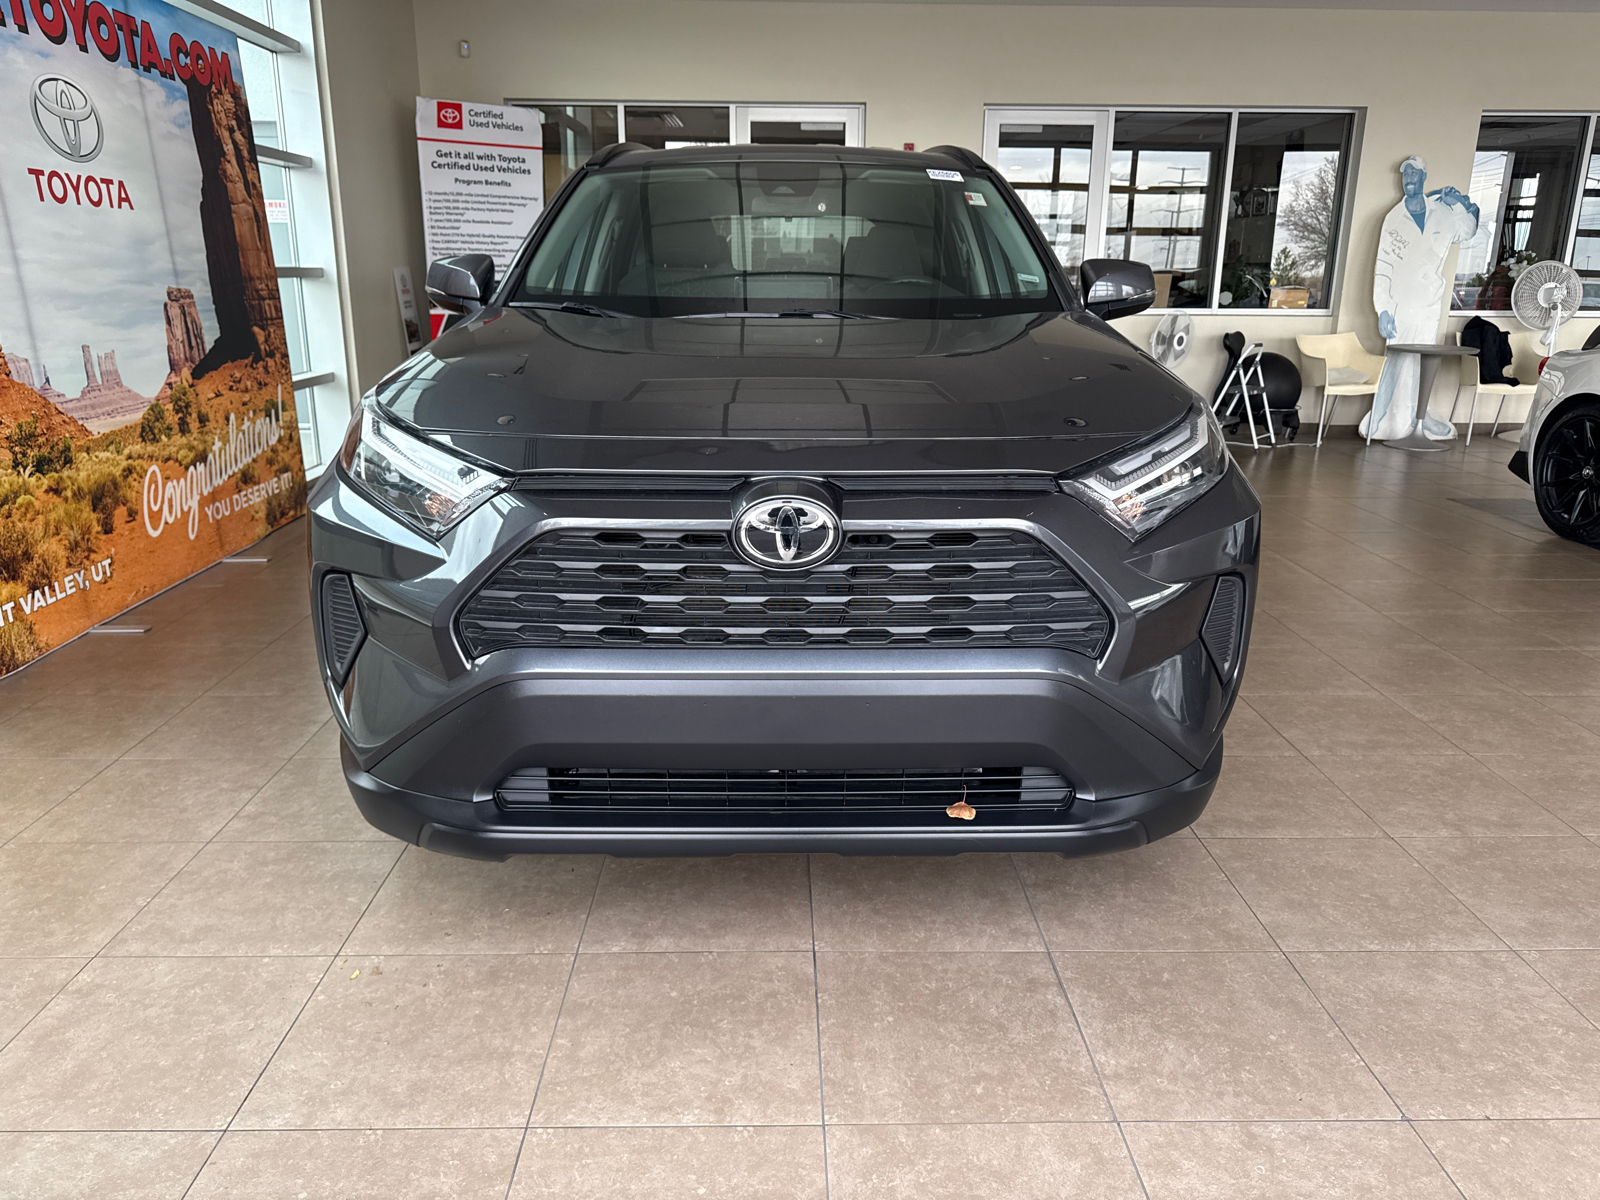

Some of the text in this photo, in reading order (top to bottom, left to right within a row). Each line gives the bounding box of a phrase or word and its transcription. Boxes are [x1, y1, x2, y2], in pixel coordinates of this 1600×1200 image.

[0, 0, 235, 94] OYOTA.COM
[468, 108, 504, 120] Certified
[468, 119, 524, 132] Used Vehicles
[431, 160, 532, 175] Certified Used Vehicles
[436, 149, 526, 164] Get it all with Toyota
[27, 168, 135, 211] TOYOTA
[454, 178, 512, 188] Program Benefits
[143, 384, 285, 540] Congratulations!
[204, 471, 293, 524] YOU DESERVE IT!
[18, 569, 90, 615] VALLEY,
[91, 557, 112, 582] UT
